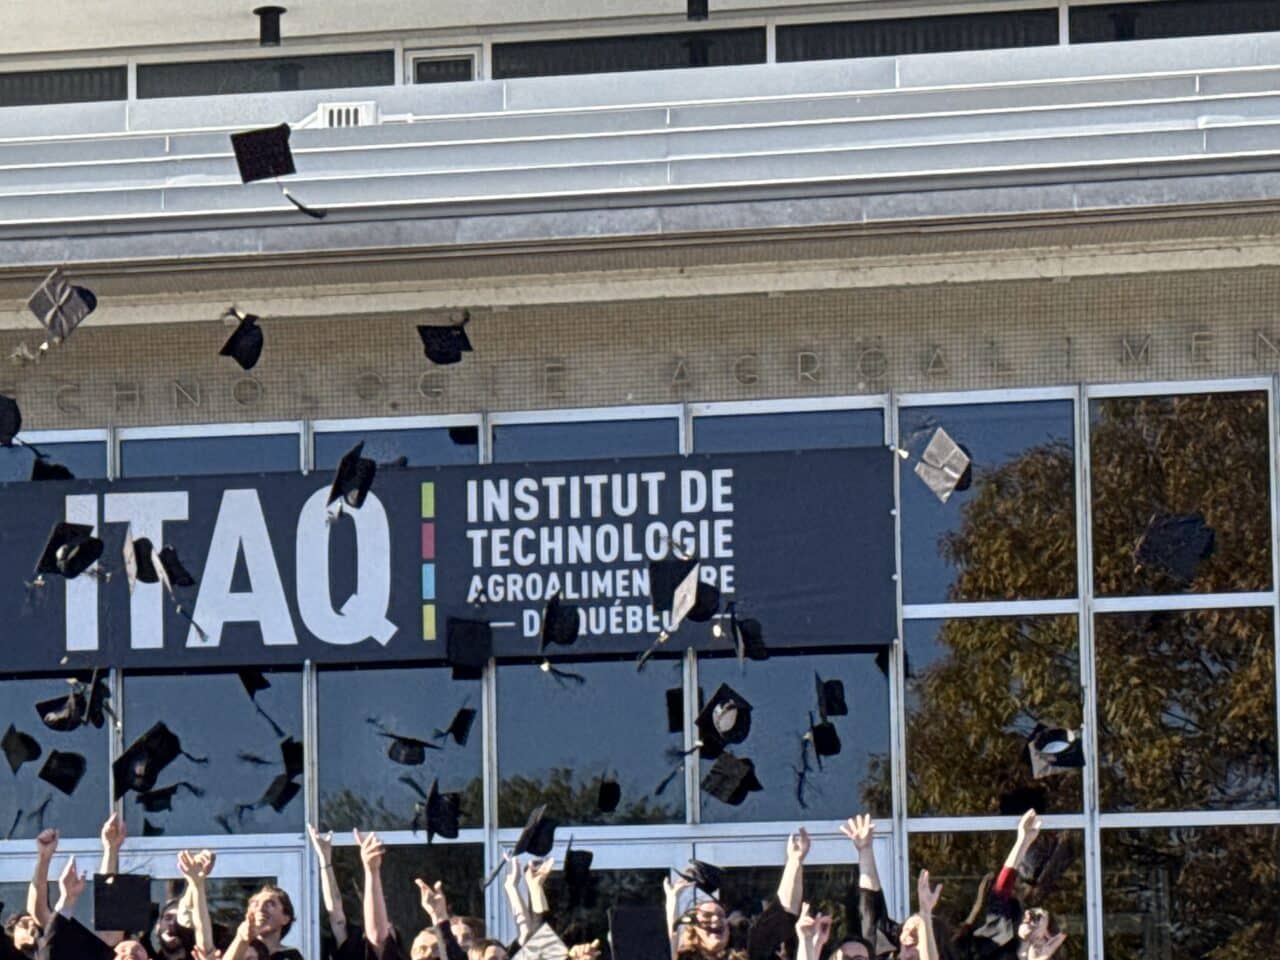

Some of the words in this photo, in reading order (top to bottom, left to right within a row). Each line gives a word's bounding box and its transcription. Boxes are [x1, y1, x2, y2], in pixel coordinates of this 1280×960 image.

[467, 471, 666, 523] INSTITUT
[680, 468, 735, 513] DE
[65, 484, 399, 651] ITAQ
[466, 519, 734, 568] TECHNOLOGIE
[466, 565, 735, 603] AGROALIMENRE
